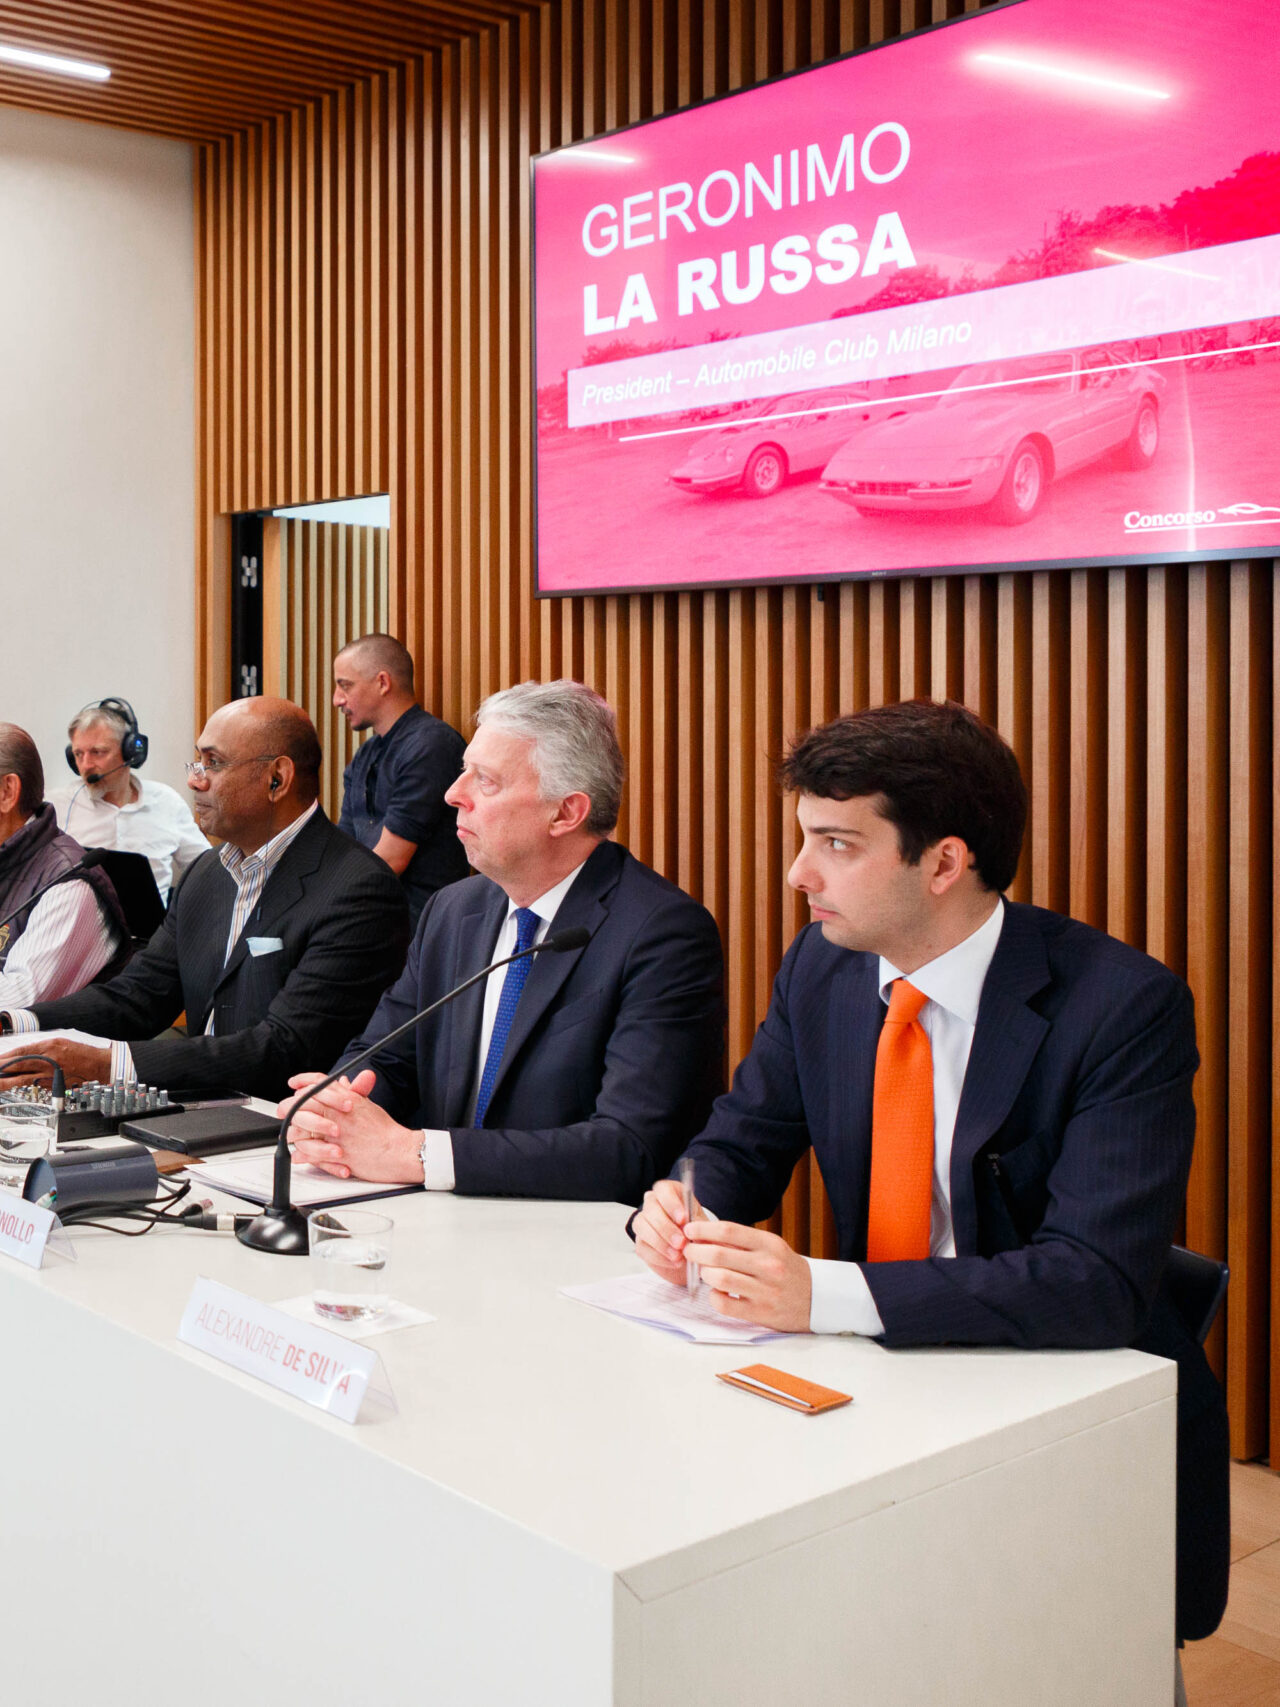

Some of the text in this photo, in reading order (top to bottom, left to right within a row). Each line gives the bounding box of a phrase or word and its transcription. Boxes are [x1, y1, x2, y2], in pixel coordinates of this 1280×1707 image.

[581, 121, 911, 258] GERONIMO
[583, 211, 917, 336] LA RUSSA
[581, 369, 673, 407] President
[694, 348, 816, 388] Automobile
[824, 334, 879, 366] Club
[885, 321, 972, 356] Milano
[1123, 510, 1216, 529] Concorso
[195, 1302, 285, 1362] ALEXANDRE
[282, 1343, 305, 1372] DE
